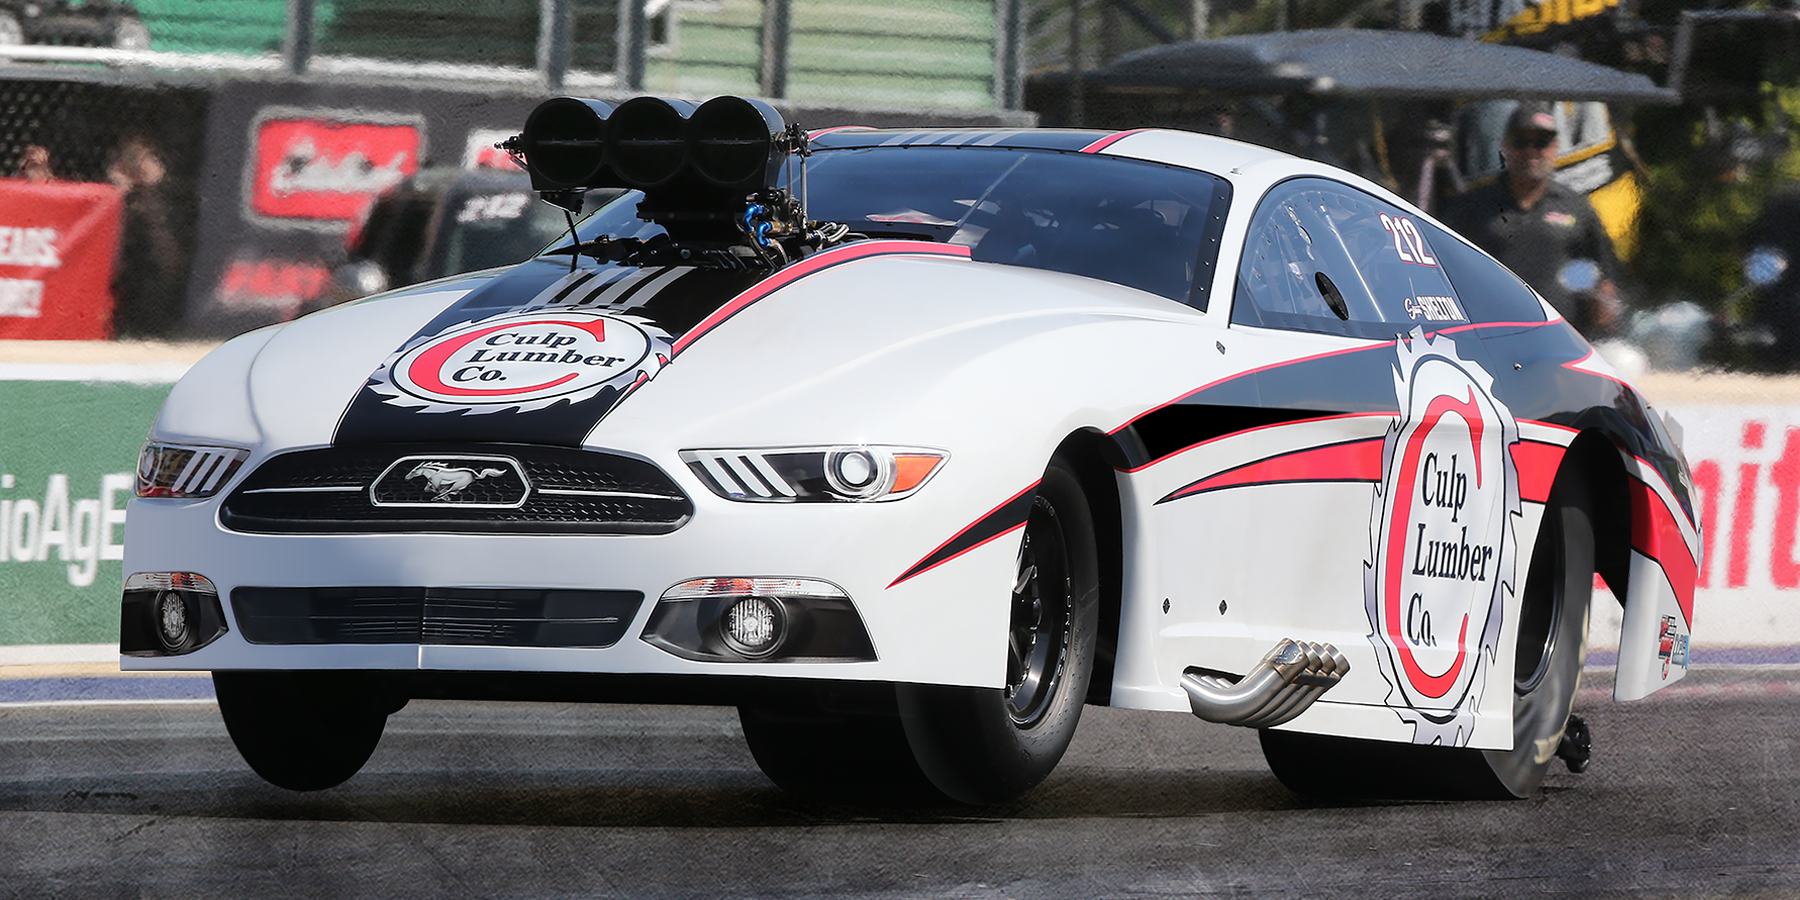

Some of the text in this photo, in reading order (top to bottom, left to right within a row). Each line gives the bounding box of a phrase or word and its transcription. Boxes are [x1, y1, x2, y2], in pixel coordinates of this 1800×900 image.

[1379, 211, 1438, 267] 212
[1416, 296, 1466, 321] SHELTON
[464, 349, 625, 368] Lumber
[485, 332, 577, 348] Culp
[452, 365, 507, 382] Co.
[1421, 451, 1467, 523] Culp
[1411, 522, 1493, 582] Lumber
[1406, 592, 1438, 647] Co.
